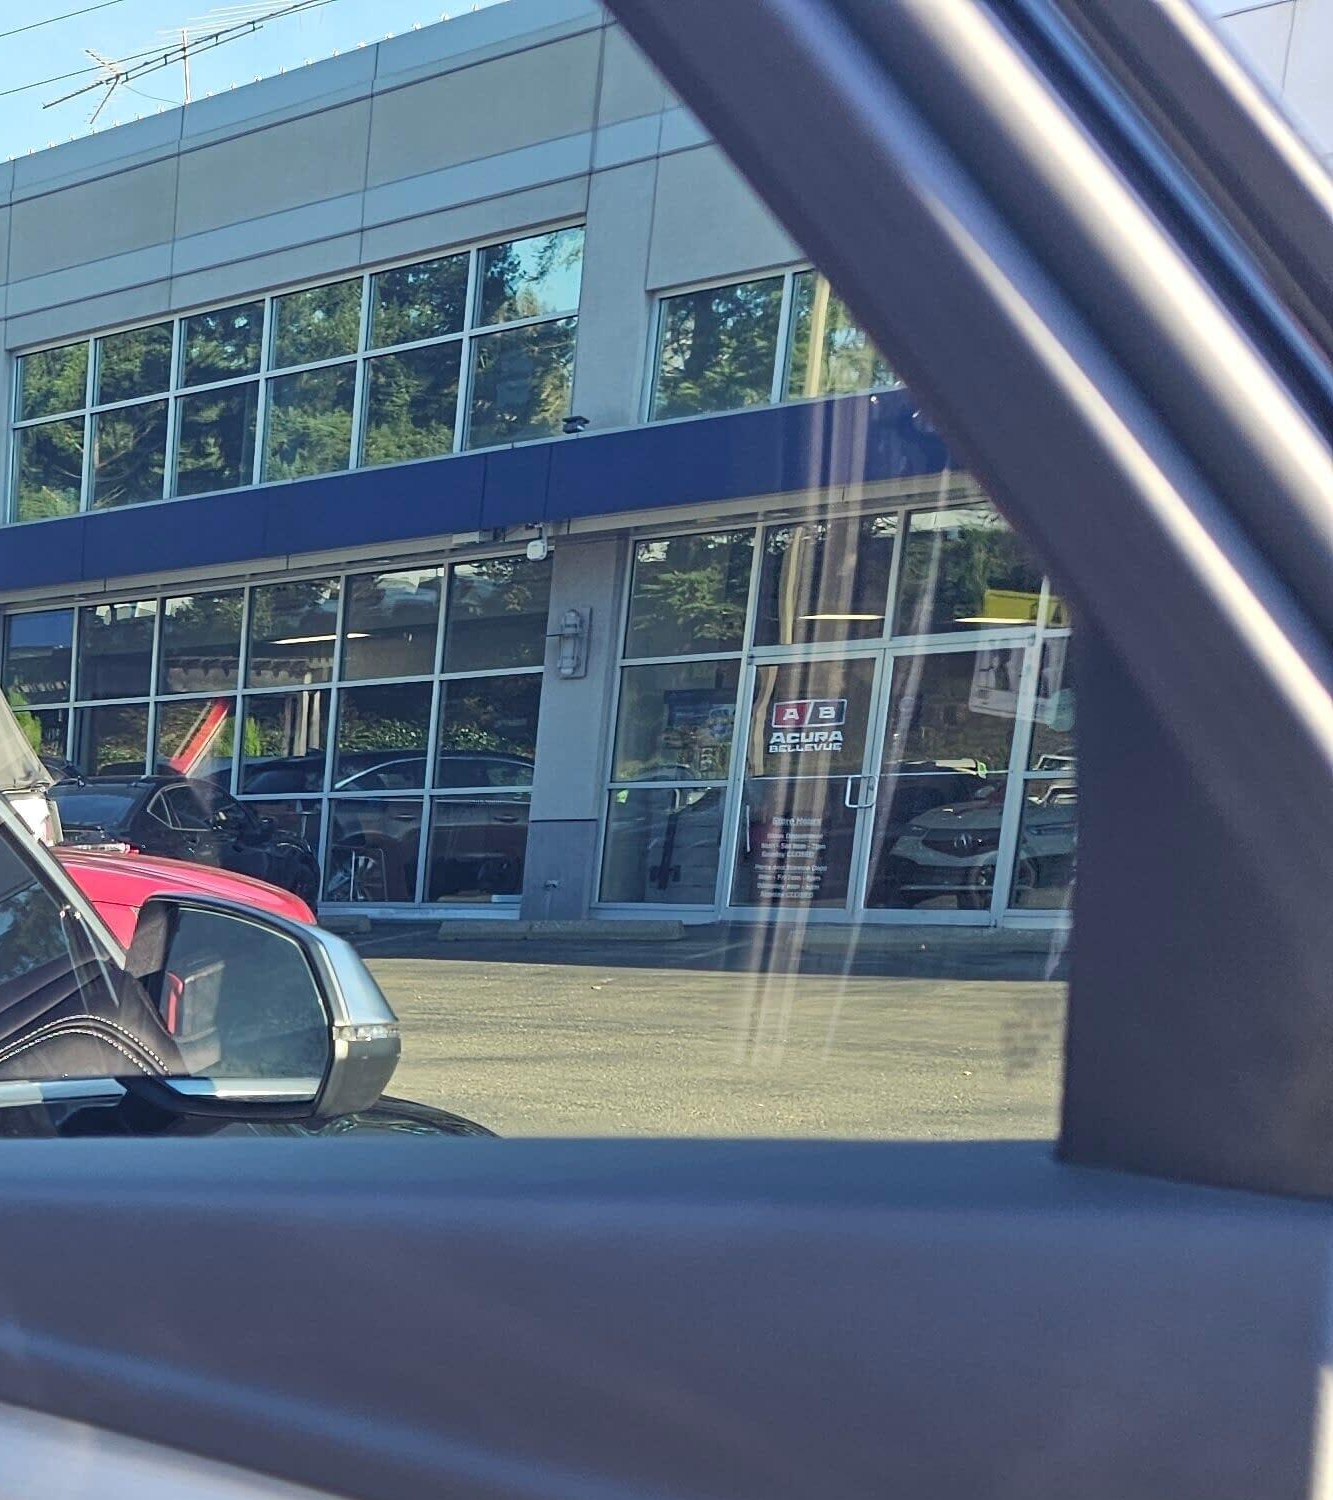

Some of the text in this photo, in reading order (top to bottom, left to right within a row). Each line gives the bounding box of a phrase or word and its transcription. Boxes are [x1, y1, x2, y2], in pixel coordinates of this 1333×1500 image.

[782, 706, 836, 721] A B
[770, 731, 844, 743] ACURA
[768, 743, 843, 753] BELLEVUE
